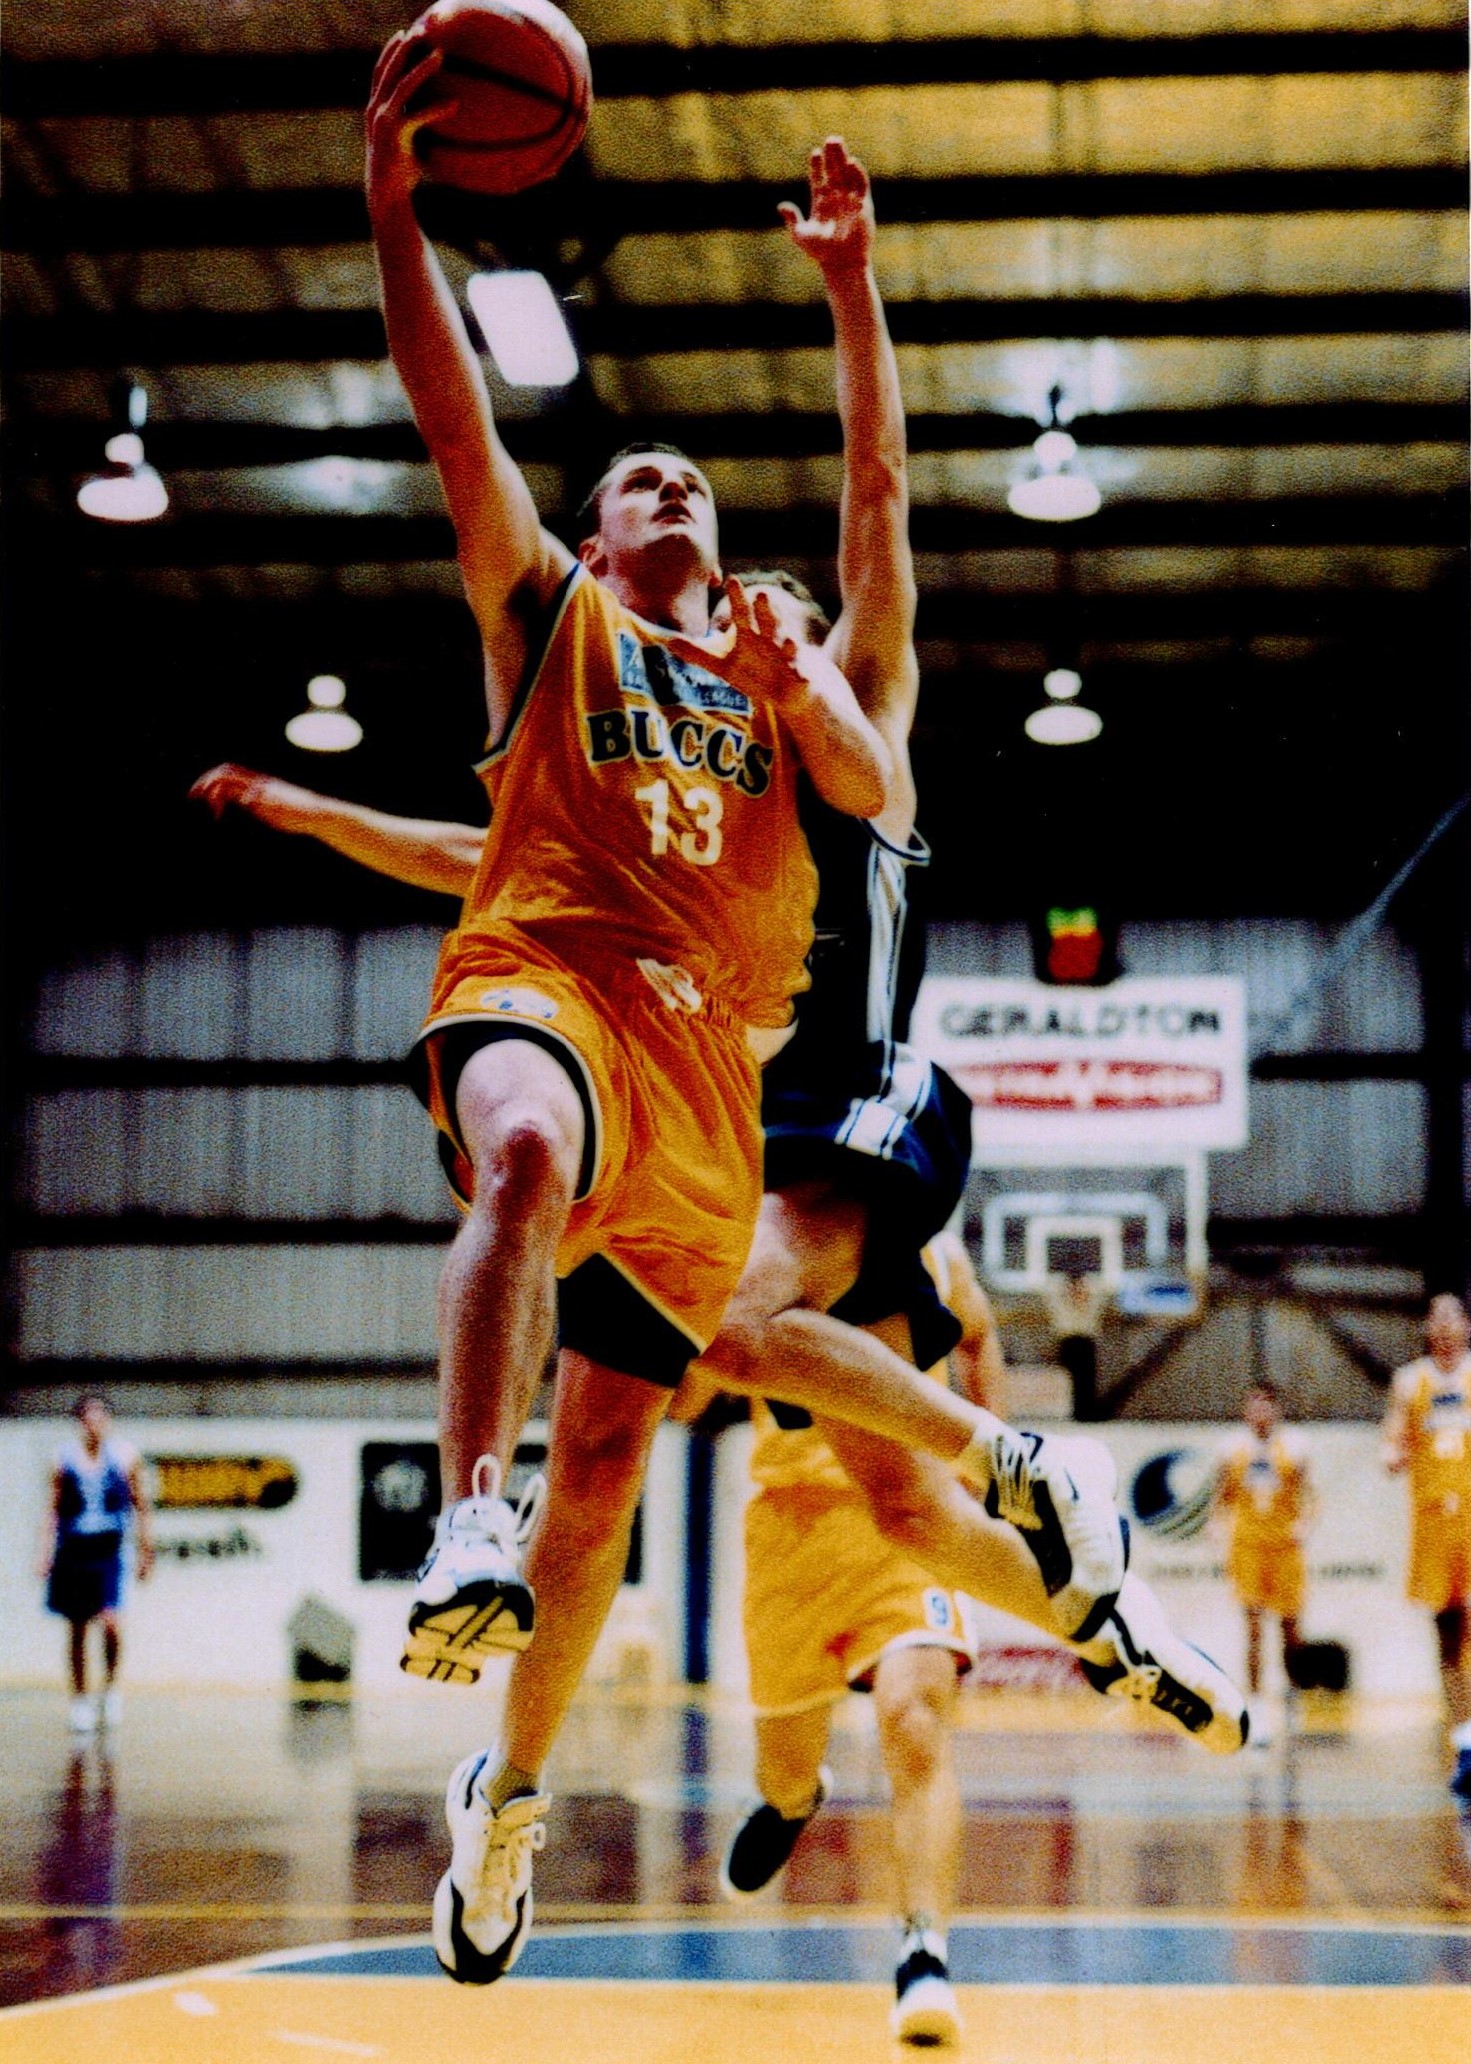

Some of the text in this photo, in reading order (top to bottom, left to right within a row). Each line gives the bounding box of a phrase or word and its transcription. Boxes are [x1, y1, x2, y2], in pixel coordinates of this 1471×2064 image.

[588, 708, 774, 796] BUCCS
[635, 779, 724, 866] 13
[939, 1002, 1221, 1038] GERALDTON
